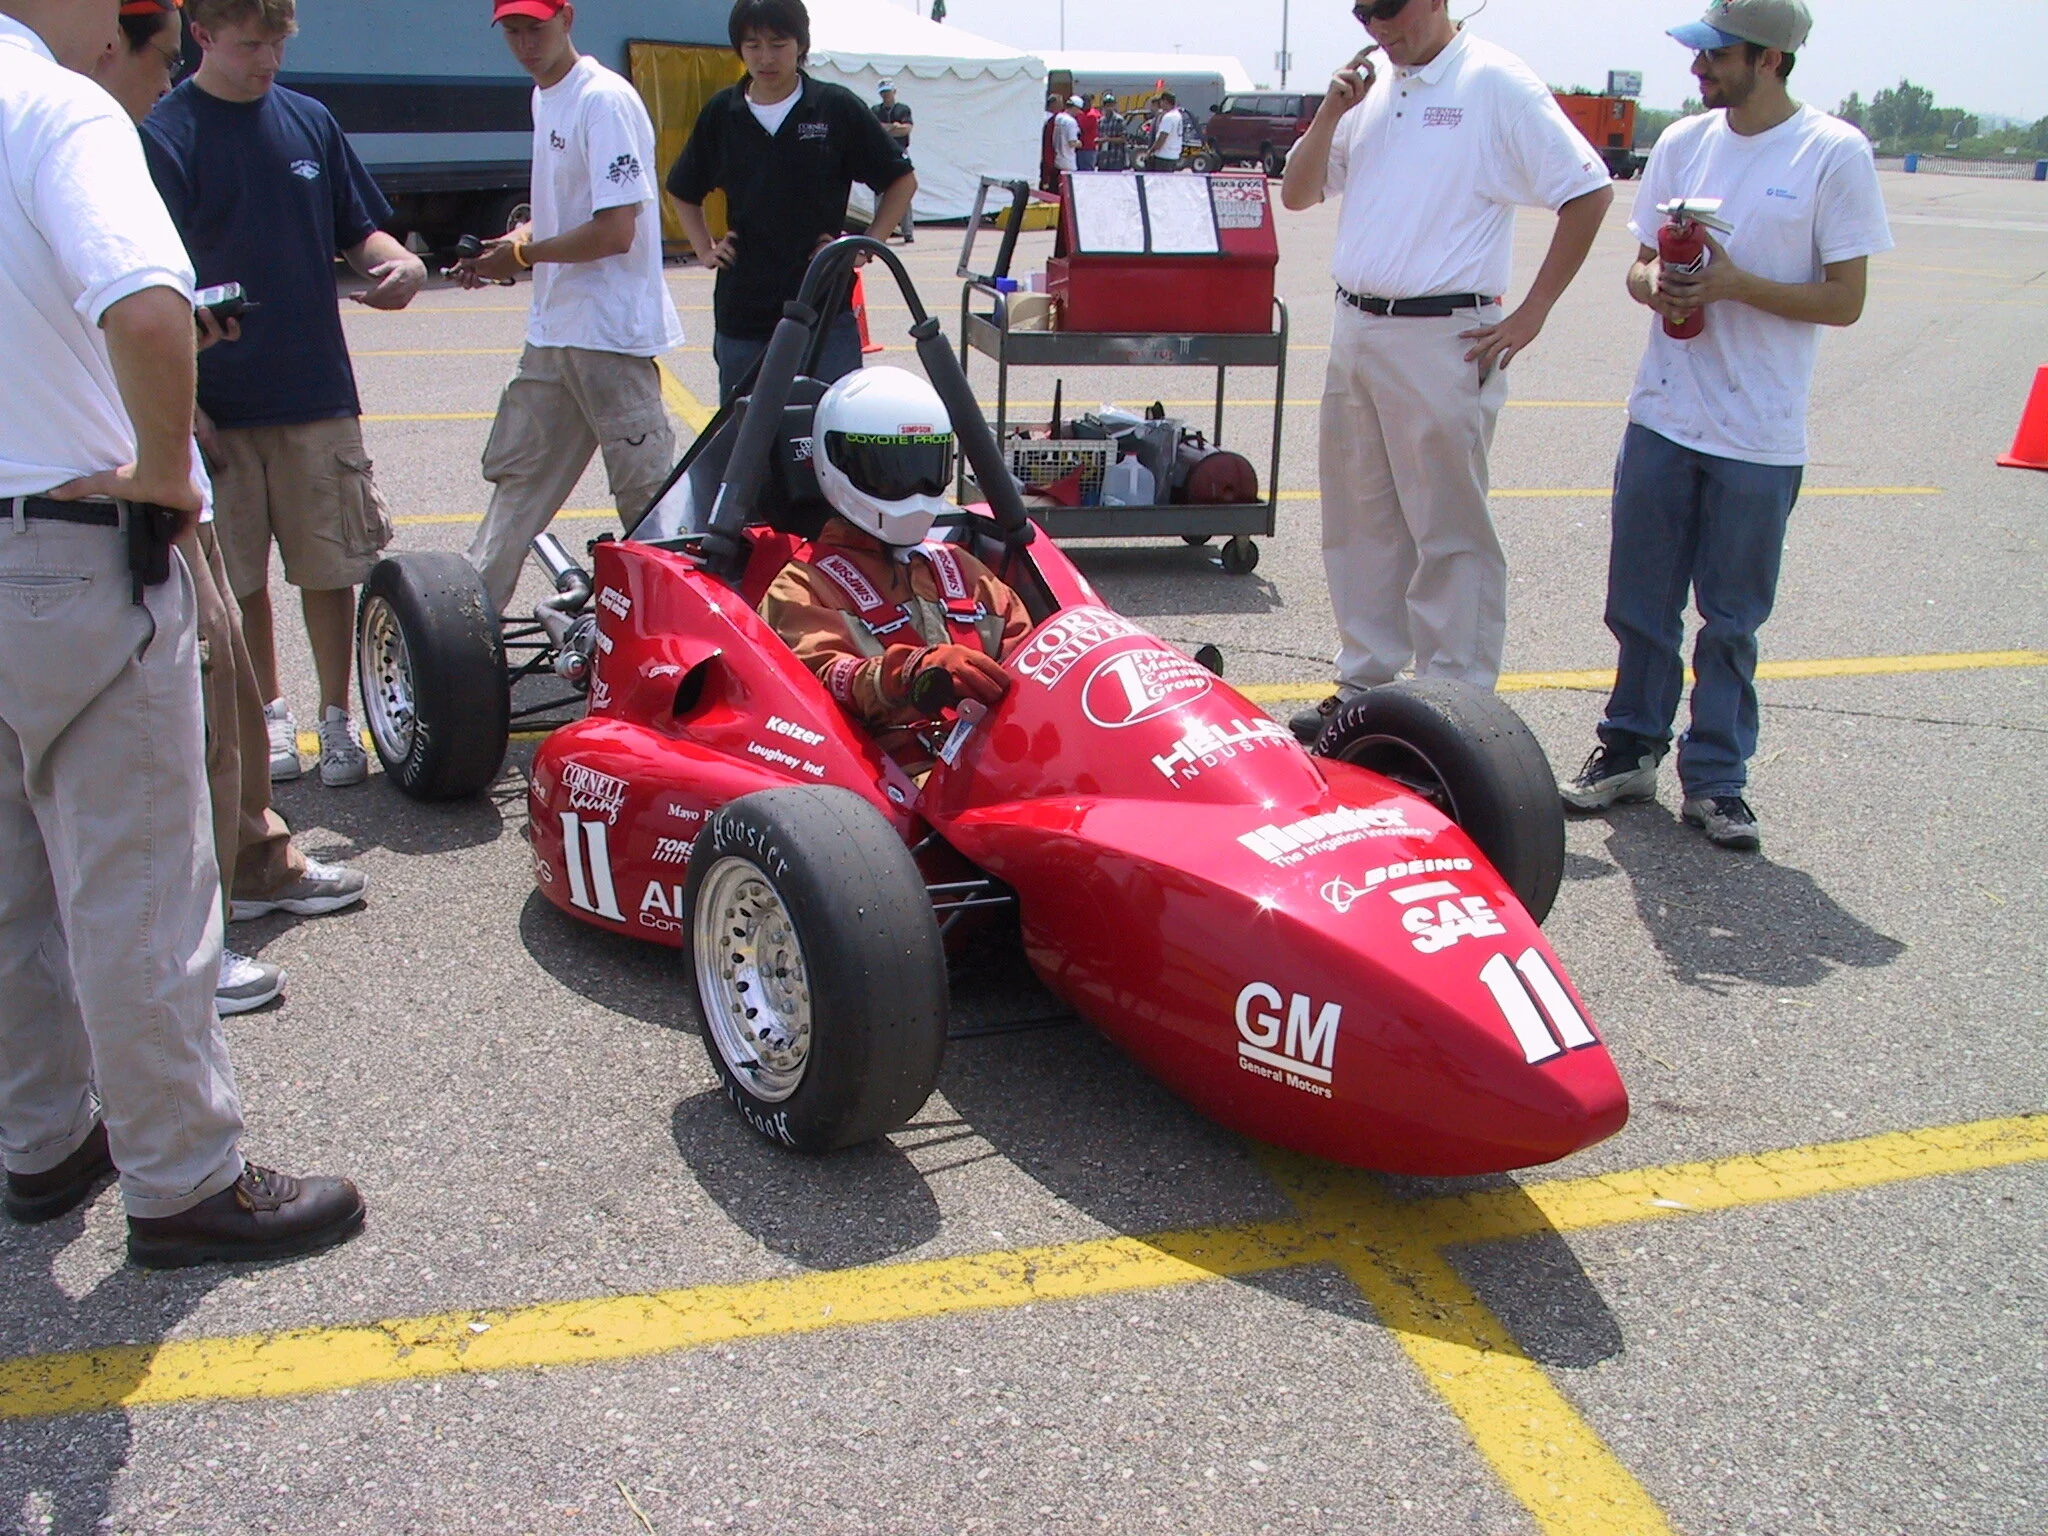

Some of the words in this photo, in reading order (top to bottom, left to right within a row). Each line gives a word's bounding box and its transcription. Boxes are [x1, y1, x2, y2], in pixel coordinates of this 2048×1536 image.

[845, 433, 908, 445] COYOTE
[902, 425, 931, 434] SIMPSON
[828, 560, 874, 602] SIMPSON
[1100, 655, 1162, 723] 1
[1148, 678, 1206, 698] Group
[747, 741, 801, 769] Loughrey
[802, 760, 825, 777] Ind.
[563, 764, 627, 804] CORNELL
[568, 784, 624, 826] Racing
[668, 803, 699, 821] Mayo
[1236, 805, 1408, 861] Hunter
[712, 806, 789, 878] Hoosier
[1269, 851, 1305, 868] The
[1302, 830, 1366, 857] Irrigation
[558, 811, 628, 923] 11
[1363, 858, 1473, 887] BOEING
[1401, 895, 1507, 953] SAE
[1235, 981, 1342, 1068] GM
[1478, 946, 1599, 1065] 11
[1238, 1056, 1284, 1083] General
[1286, 1073, 1332, 1099] Motors
